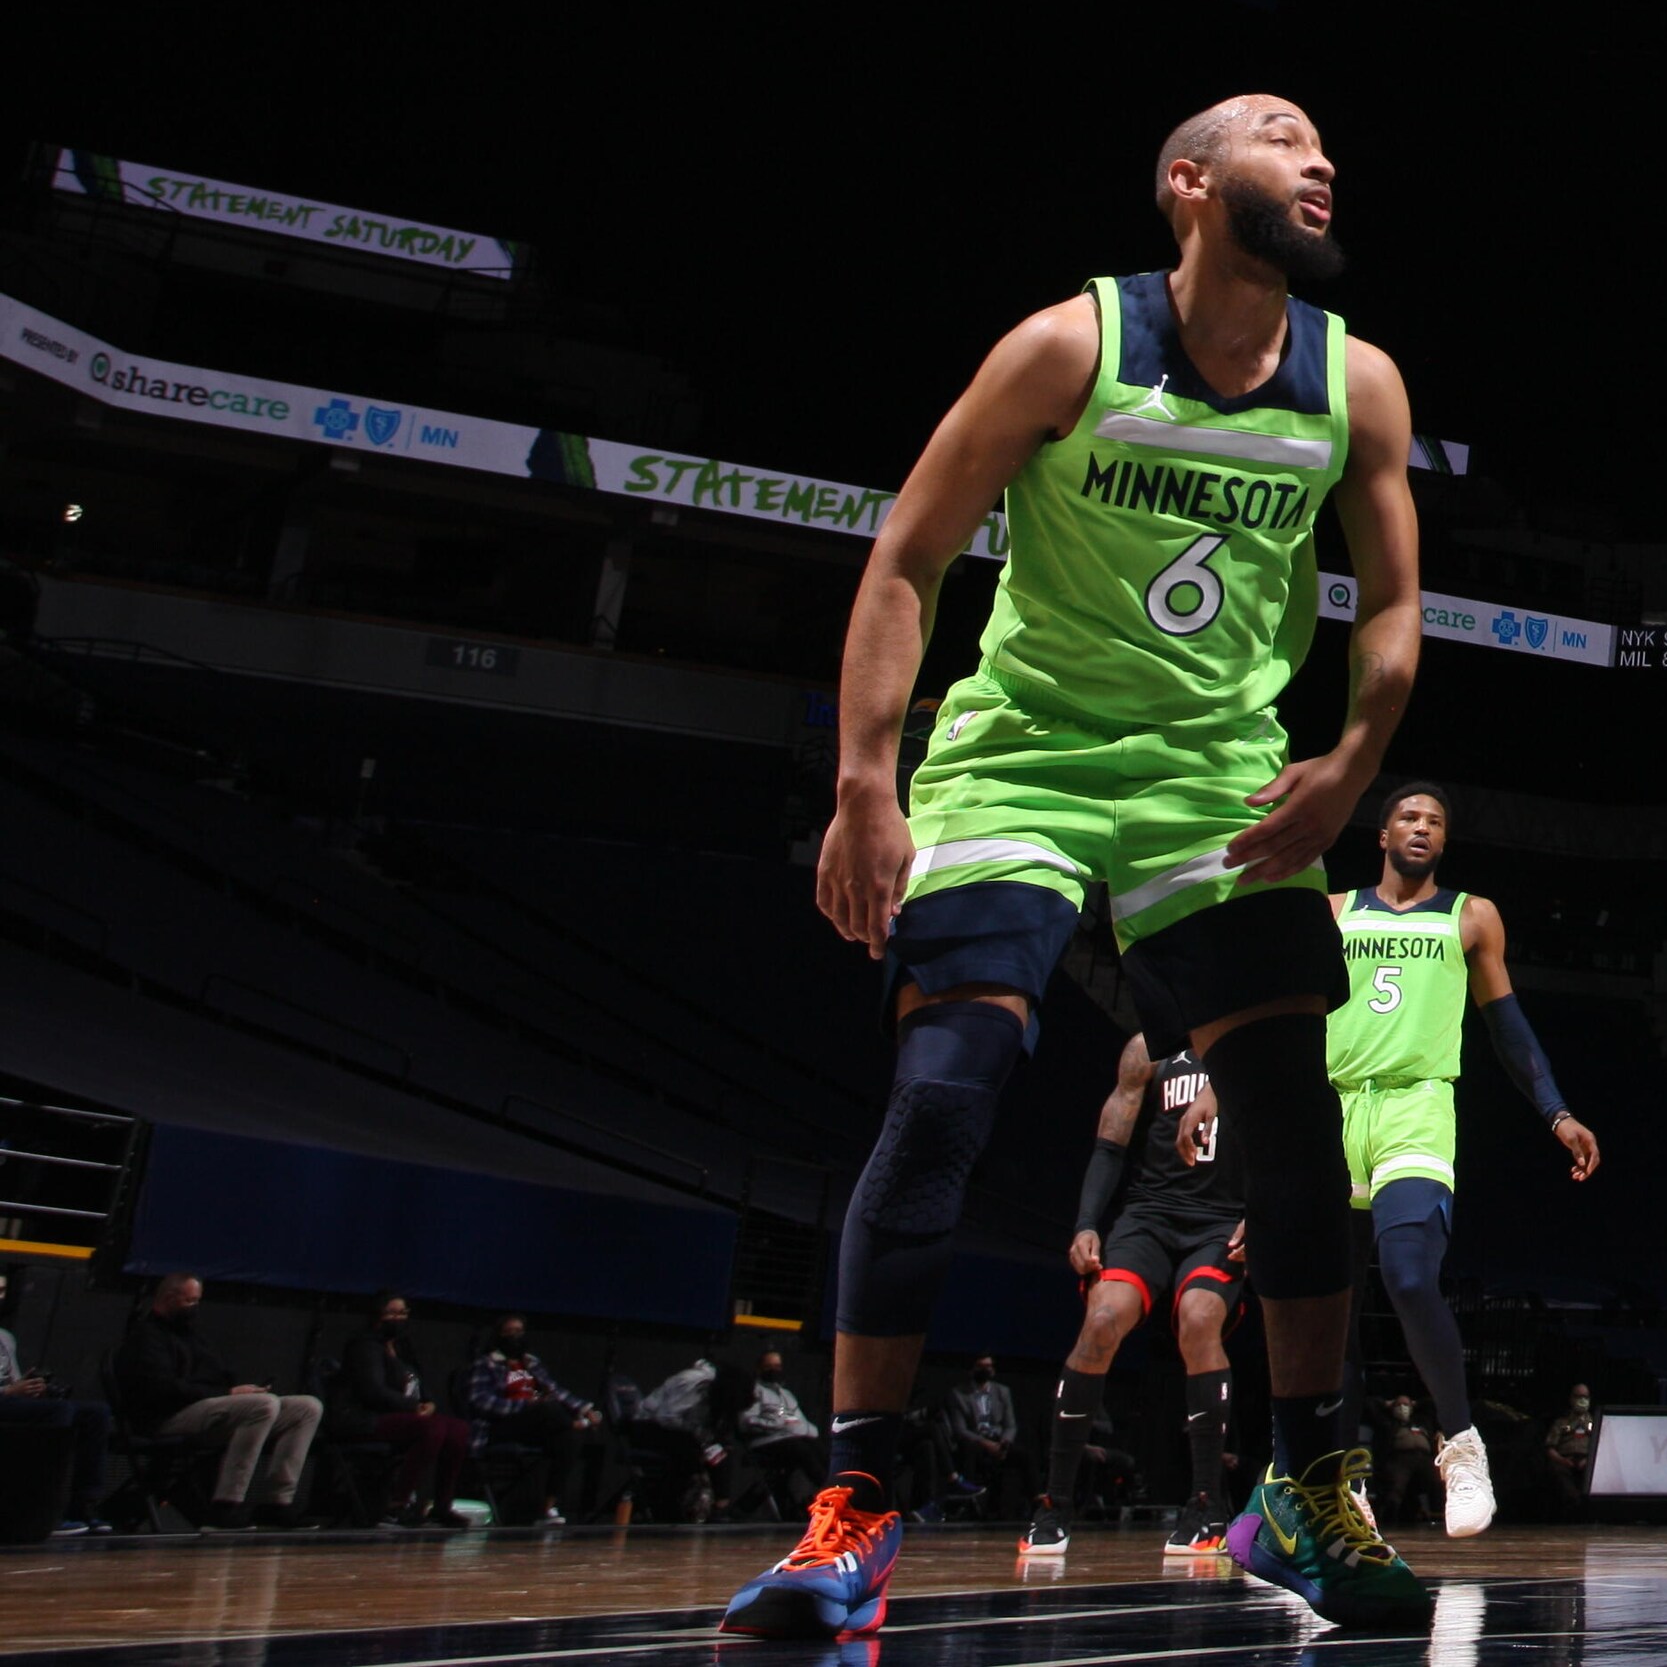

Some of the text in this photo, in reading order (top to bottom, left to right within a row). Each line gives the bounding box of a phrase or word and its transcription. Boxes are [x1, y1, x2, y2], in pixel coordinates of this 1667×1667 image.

[147, 175, 475, 263] STATEMENT SATURDAY
[112, 365, 290, 421] sharecare
[420, 424, 458, 448] MN
[624, 455, 899, 532] STATEMENT
[1080, 451, 1310, 529] MINNESOTA
[1144, 532, 1231, 636] 6
[451, 645, 497, 670] 116
[1562, 631, 1587, 649] MN
[1619, 651, 1652, 666] MIL
[1621, 630, 1655, 647] NYK
[1342, 937, 1445, 961] MINNESOTA
[1367, 965, 1403, 1015] 5
